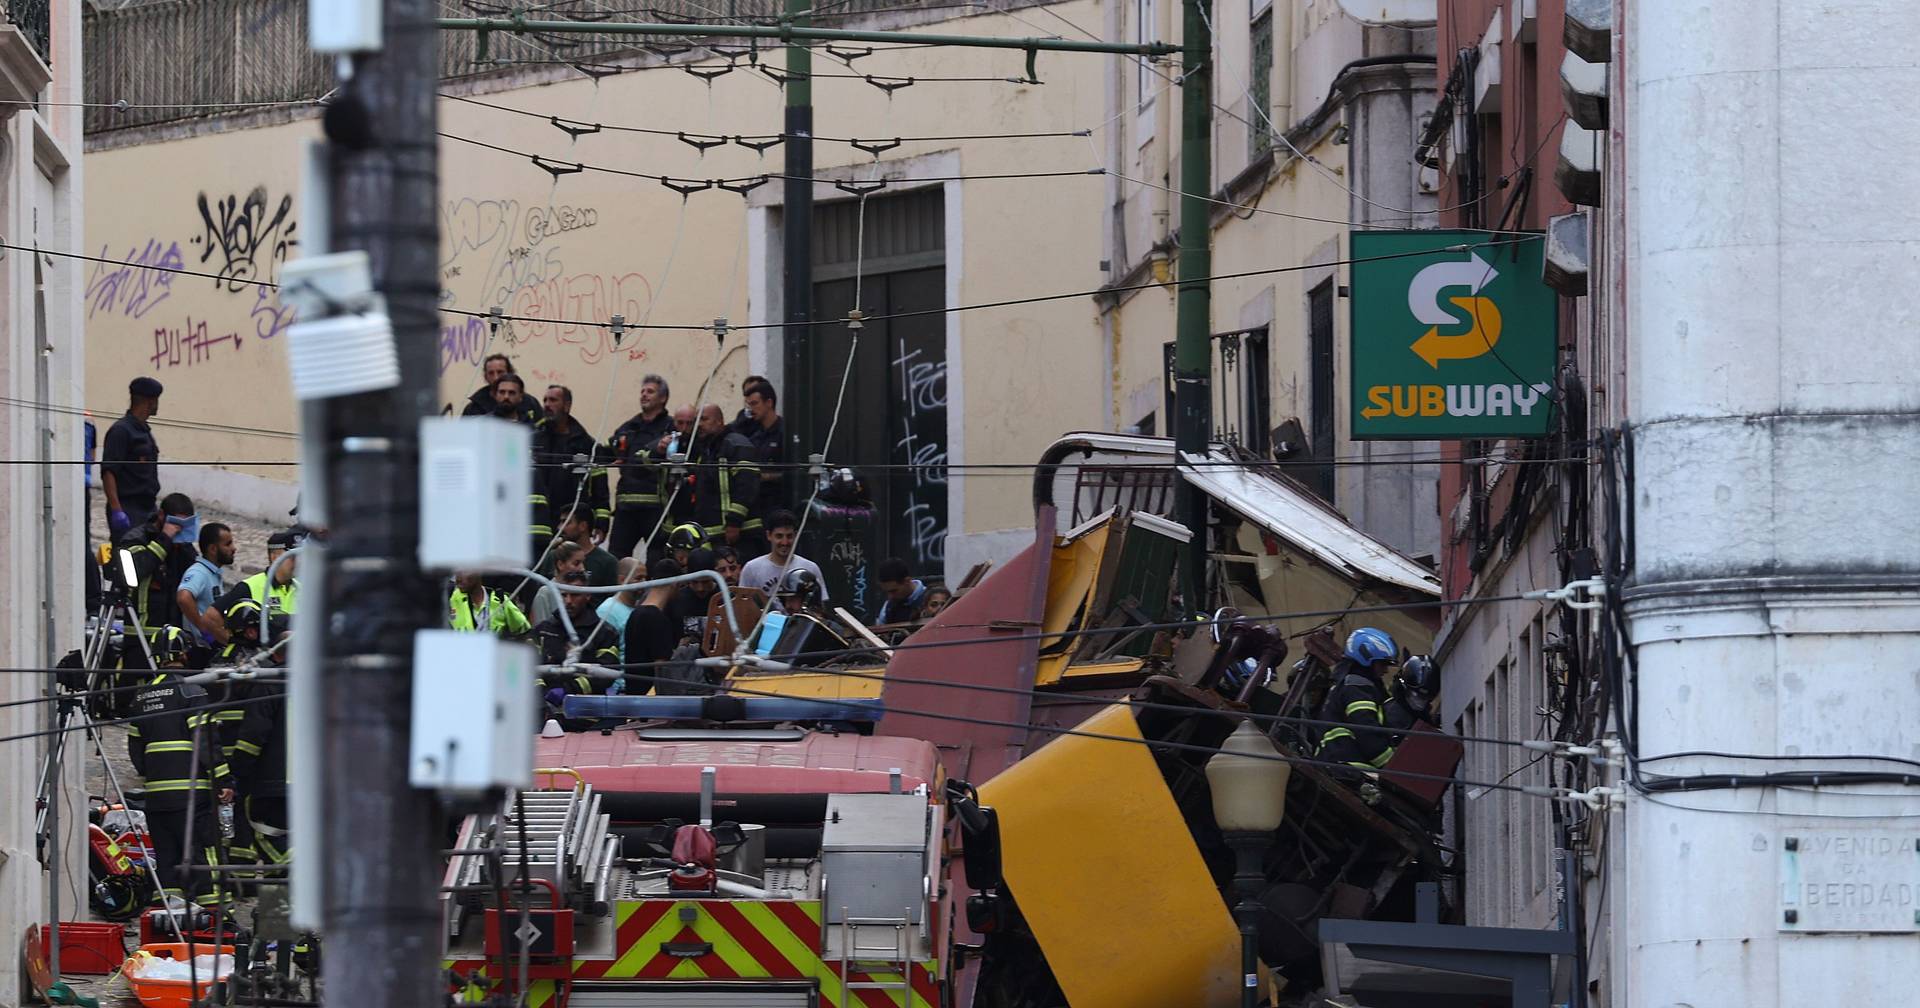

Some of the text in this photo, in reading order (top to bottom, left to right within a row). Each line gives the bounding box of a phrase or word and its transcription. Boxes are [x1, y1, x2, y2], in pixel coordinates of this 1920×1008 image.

[150, 315, 232, 371] PUTA
[1360, 381, 1552, 421] SUBWAY
[1798, 837, 1912, 855] AVENIDA
